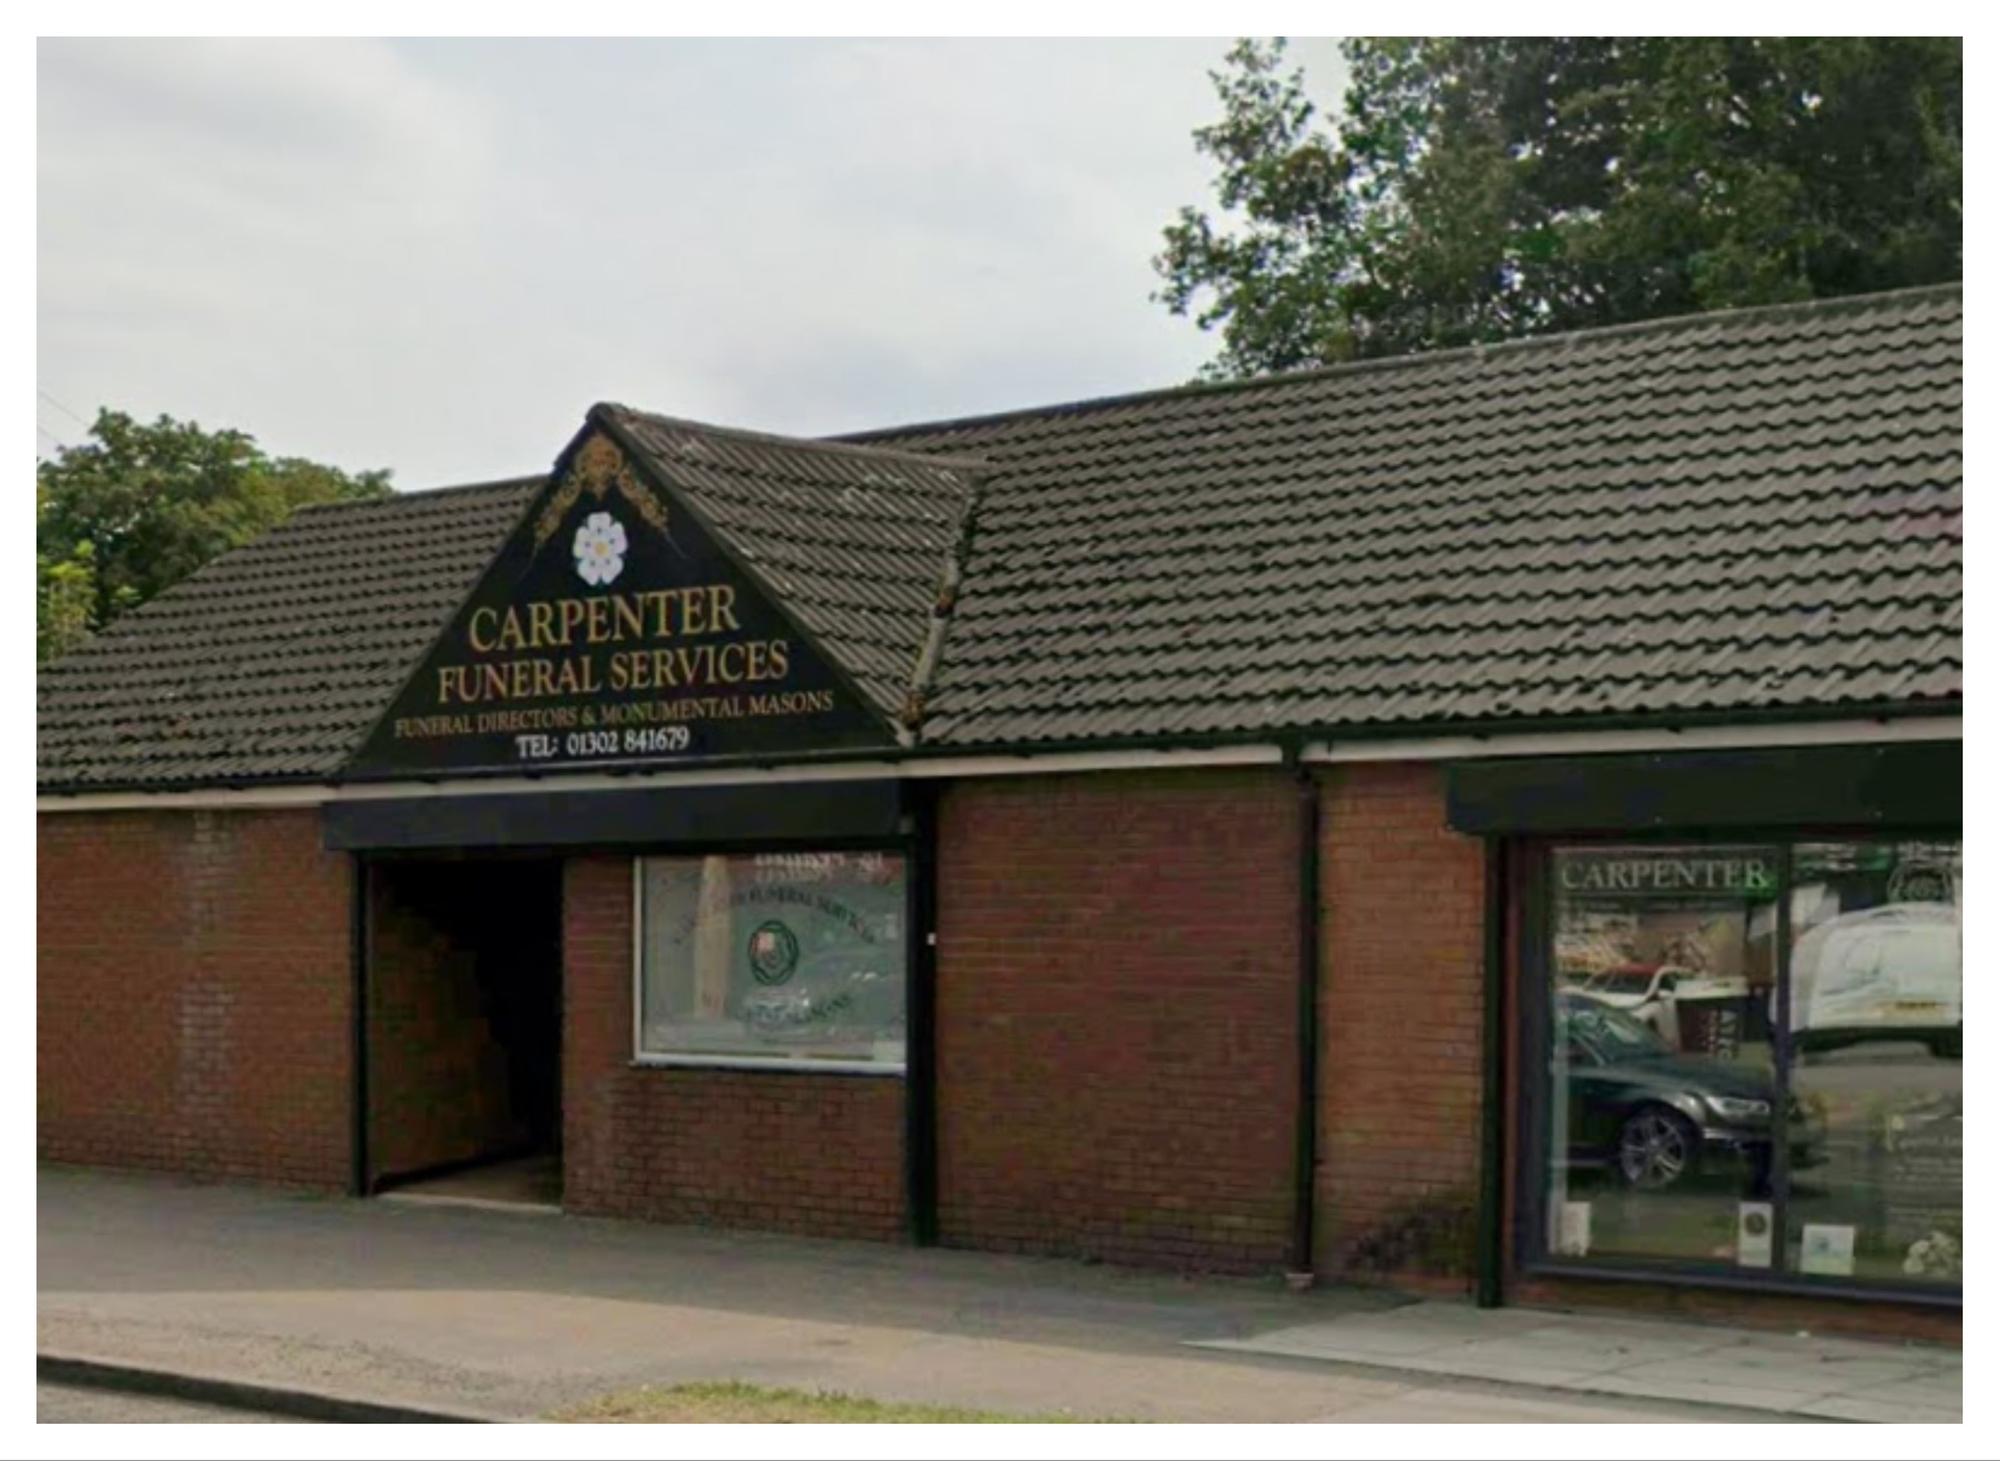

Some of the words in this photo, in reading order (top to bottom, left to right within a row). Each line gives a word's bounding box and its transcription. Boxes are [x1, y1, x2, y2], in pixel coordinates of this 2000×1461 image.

[469, 584, 740, 652] CARPENTER
[438, 655, 600, 703] FUNERAL
[610, 639, 789, 690] SERVICES
[394, 714, 474, 738] FUNERAL
[478, 706, 579, 733] DIRECTORS
[581, 707, 596, 726] &
[601, 697, 744, 725] MONUMENTAL
[515, 734, 559, 758] TEL:
[565, 731, 619, 756] 01302
[623, 726, 691, 752] 841679
[1561, 859, 1770, 889] CARPENTER
